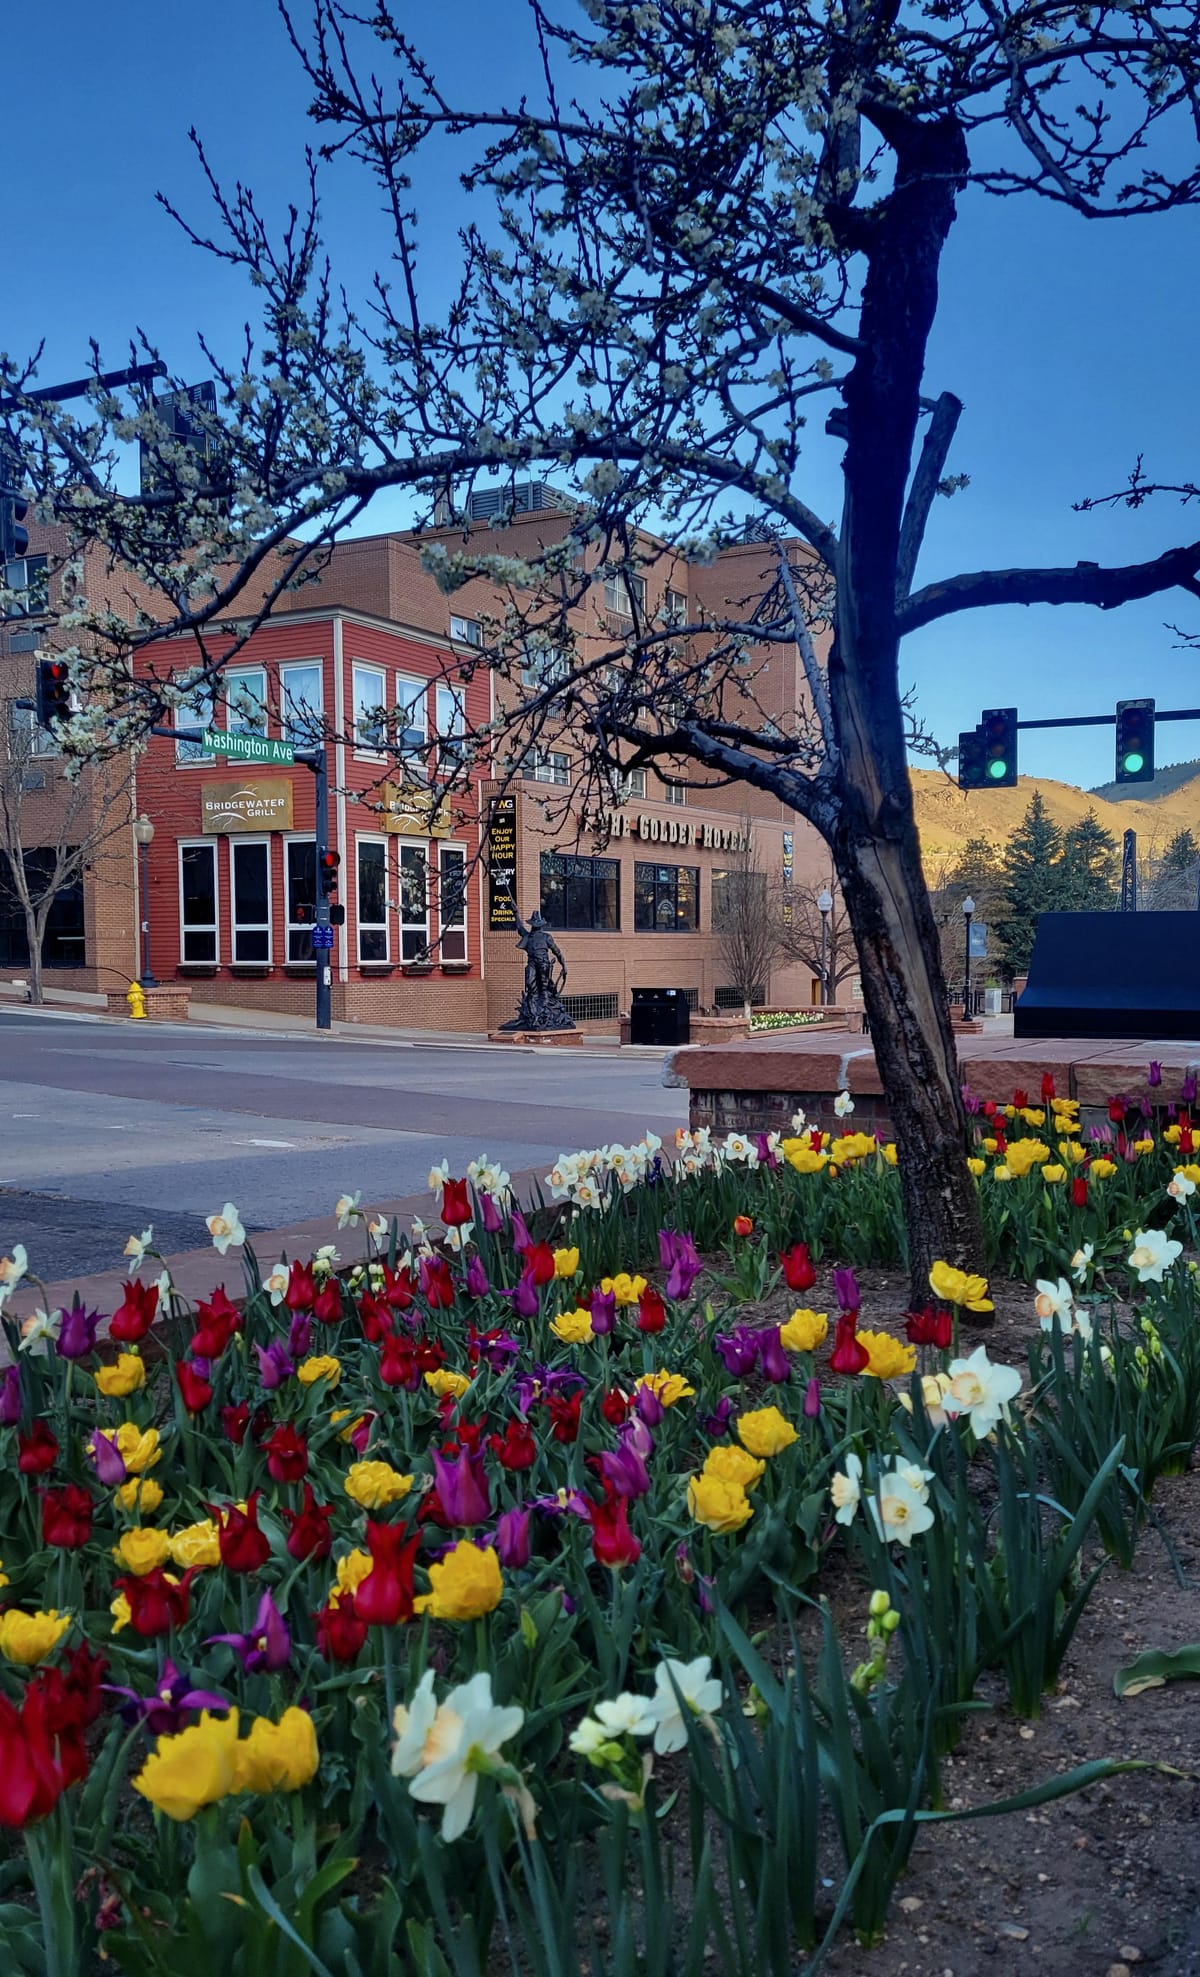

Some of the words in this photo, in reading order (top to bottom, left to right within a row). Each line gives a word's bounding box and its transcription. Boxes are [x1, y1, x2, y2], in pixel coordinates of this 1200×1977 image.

[204, 731, 269, 759] Washington
[272, 741, 293, 761] Ave
[205, 799, 285, 811] BRIDGEWATER
[247, 808, 276, 817] GRILL
[639, 814, 696, 846] GOLDEN
[703, 823, 746, 852] HOTEL
